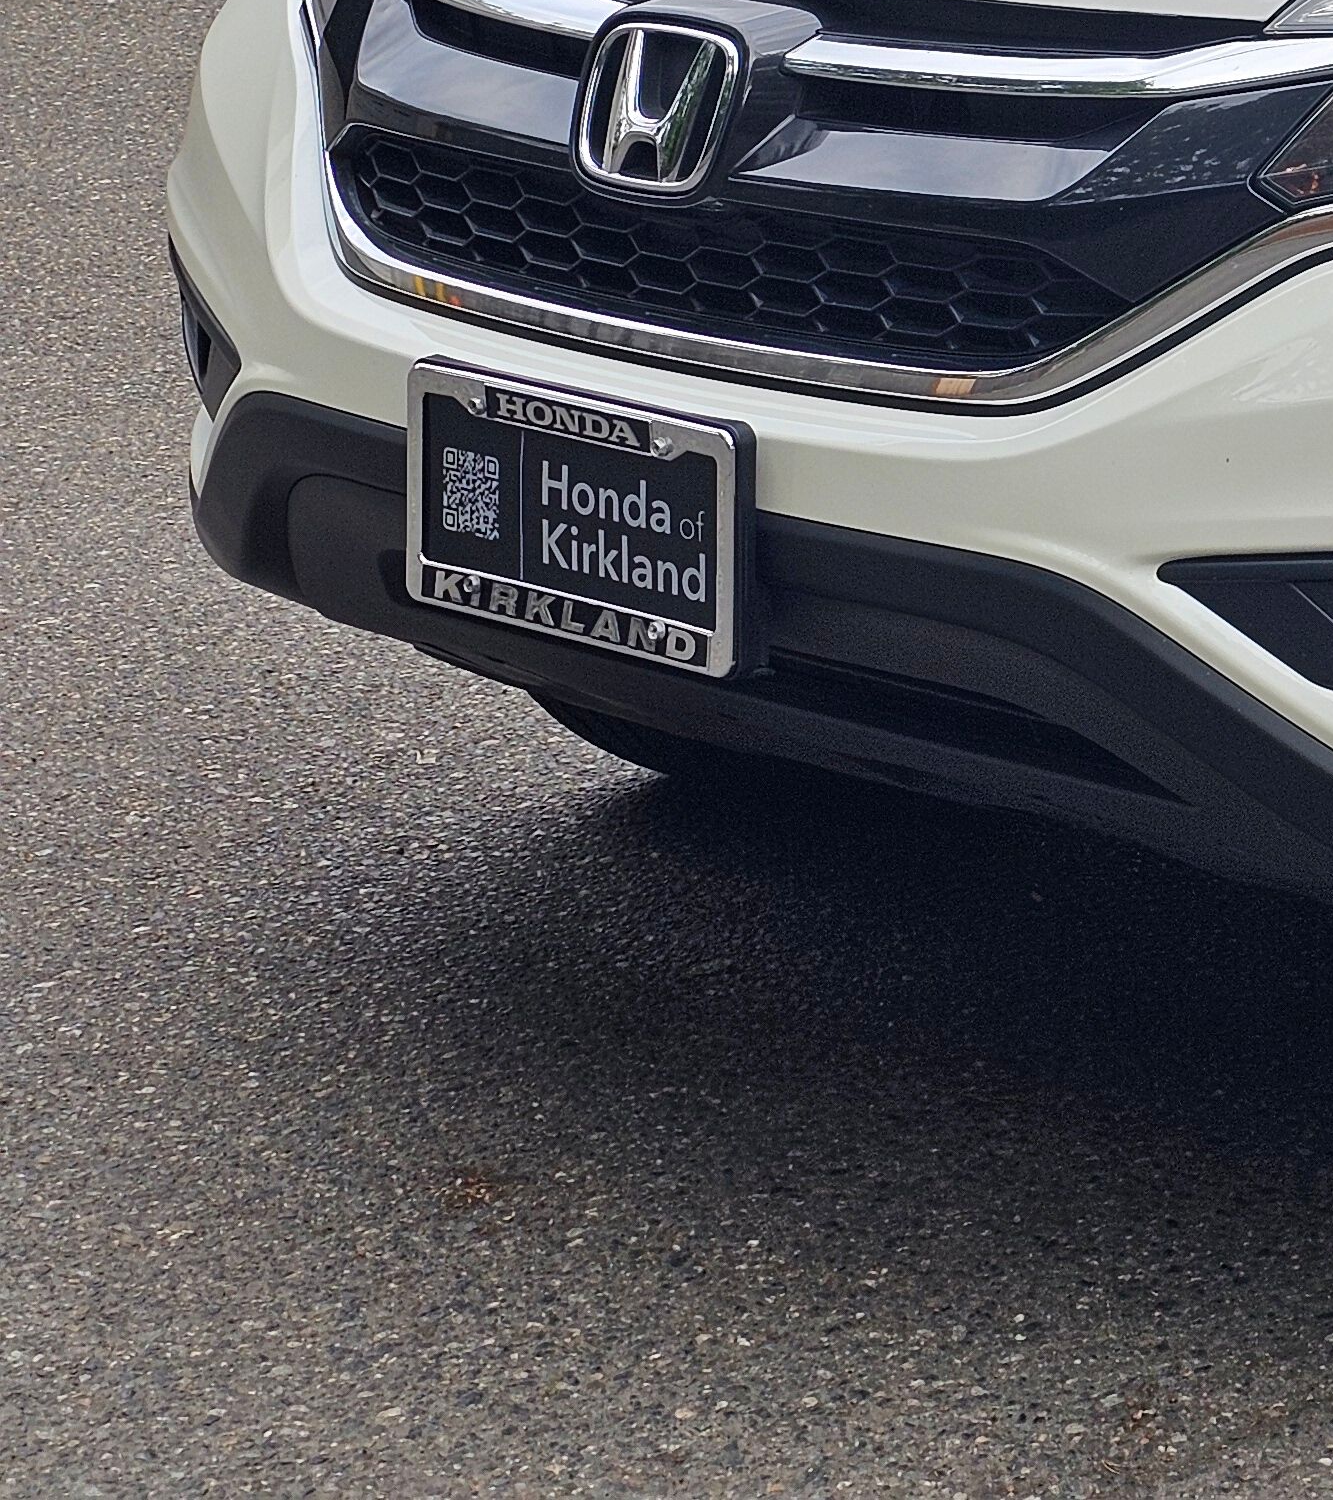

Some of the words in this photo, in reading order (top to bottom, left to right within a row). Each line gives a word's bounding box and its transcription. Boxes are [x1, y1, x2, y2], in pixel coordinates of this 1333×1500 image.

[495, 392, 641, 448] HONDA
[541, 459, 672, 535] Honda
[679, 510, 706, 542] of
[541, 518, 706, 603] Kirkland
